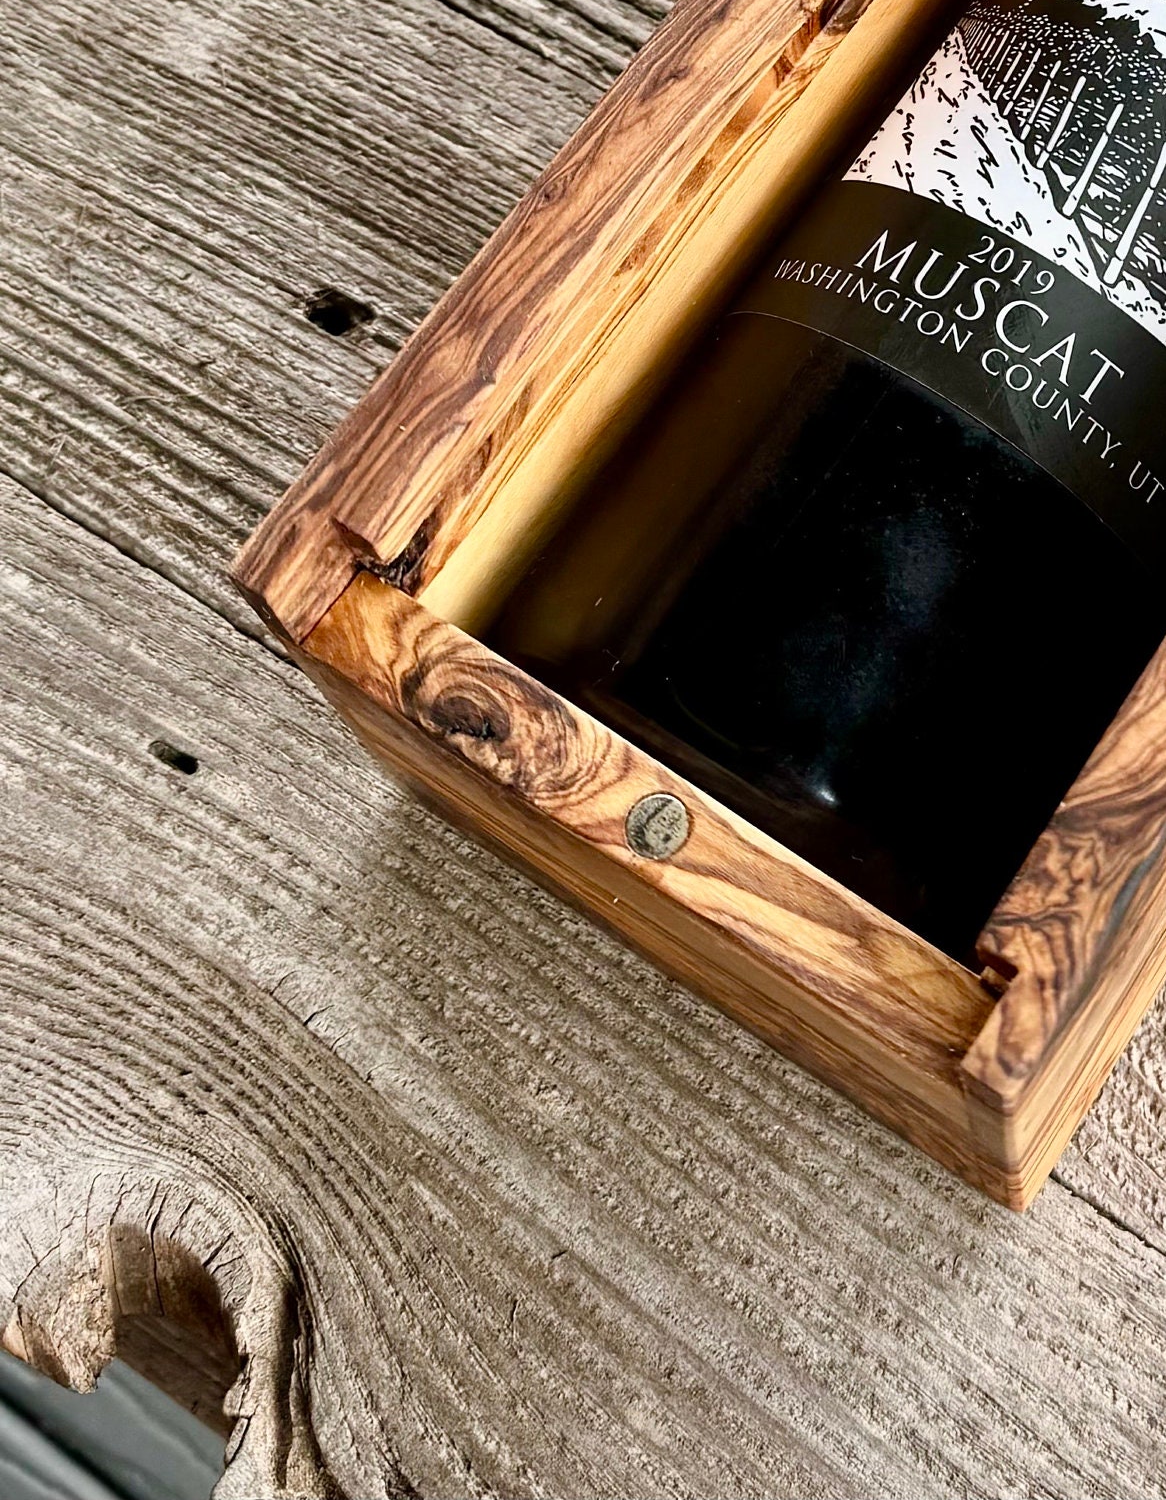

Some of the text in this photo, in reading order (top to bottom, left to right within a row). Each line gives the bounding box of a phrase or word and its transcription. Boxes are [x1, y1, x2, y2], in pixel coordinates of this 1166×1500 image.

[854, 229, 1126, 405] MUSCAT
[967, 235, 1056, 295] 2019
[774, 259, 974, 354] WASHINGTON
[981, 347, 1122, 469] COUNTY,
[1127, 461, 1166, 504] UT
